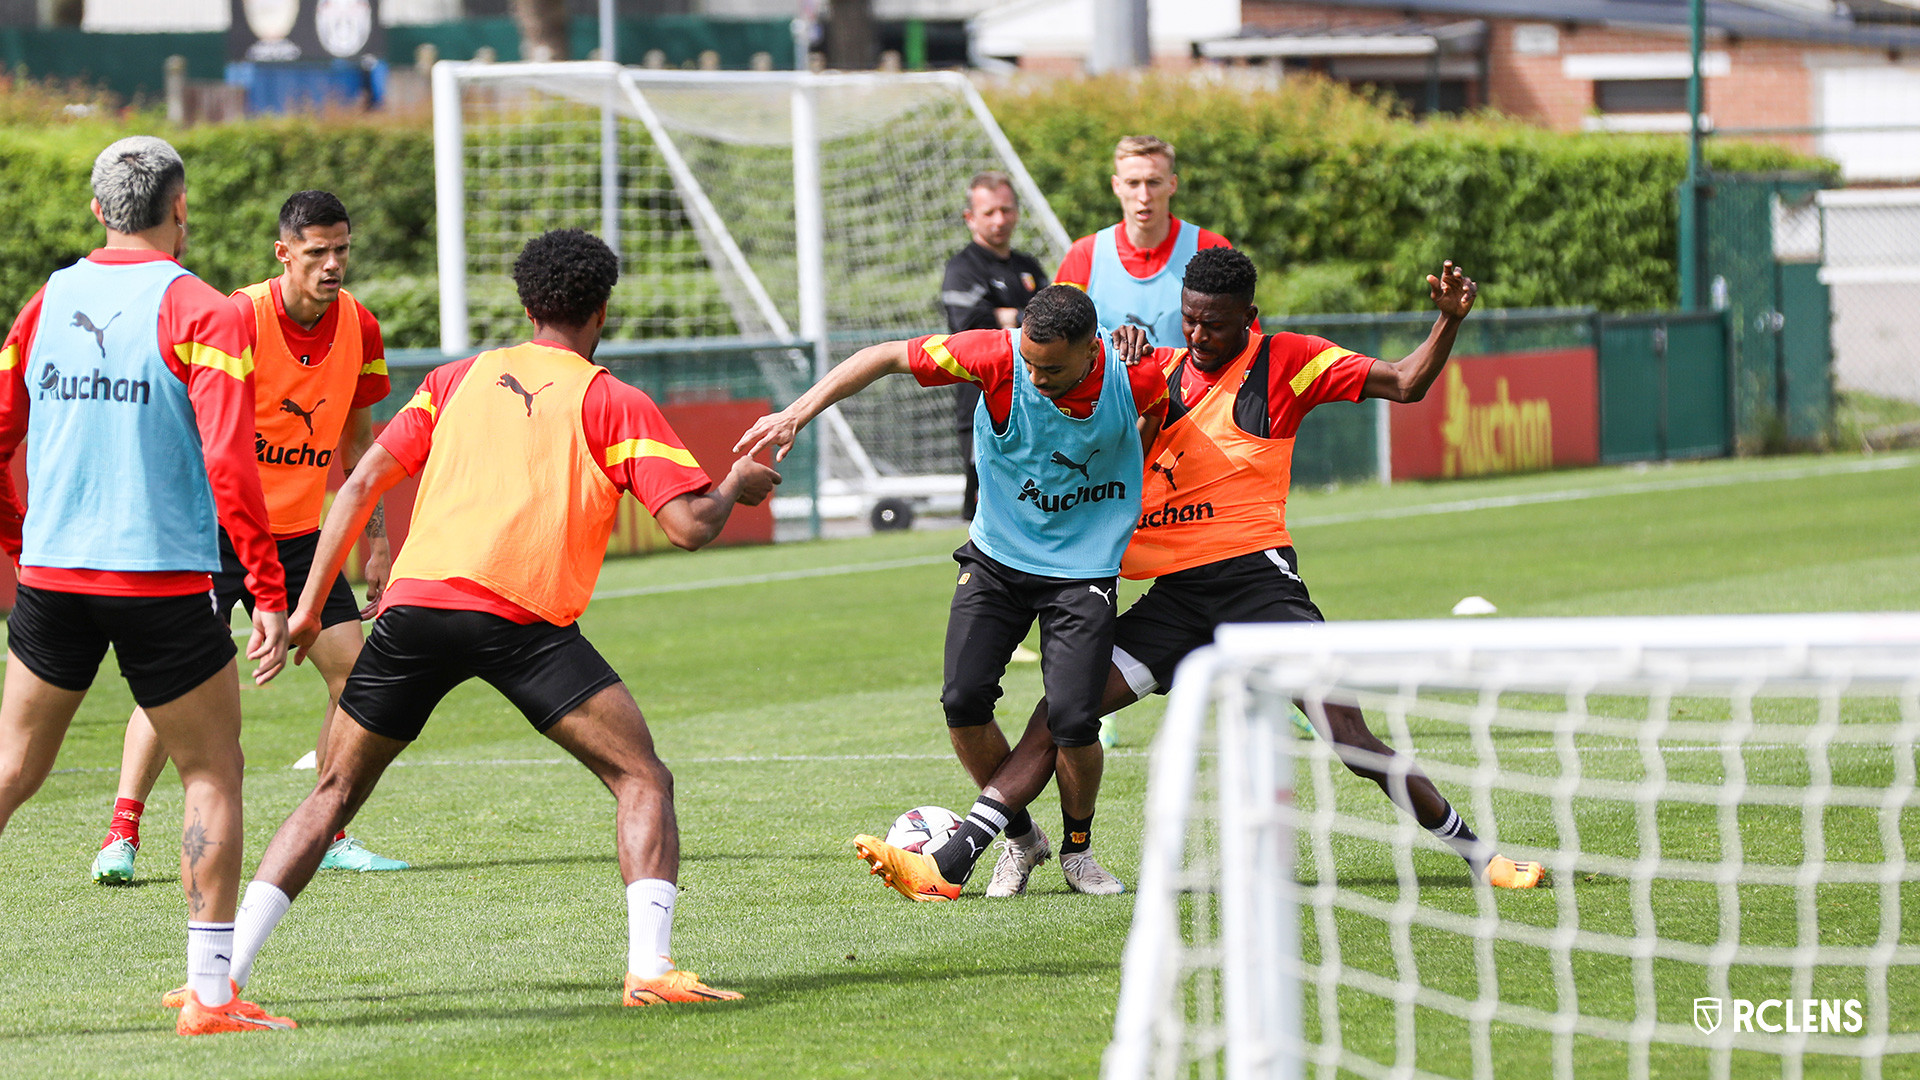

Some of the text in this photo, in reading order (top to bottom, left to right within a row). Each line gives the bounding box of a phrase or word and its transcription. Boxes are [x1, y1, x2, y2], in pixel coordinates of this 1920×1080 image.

[39, 362, 150, 405] Auchan
[1442, 361, 1553, 478] Auchan
[1017, 478, 1126, 513] Auchan
[1136, 501, 1214, 530] uchan
